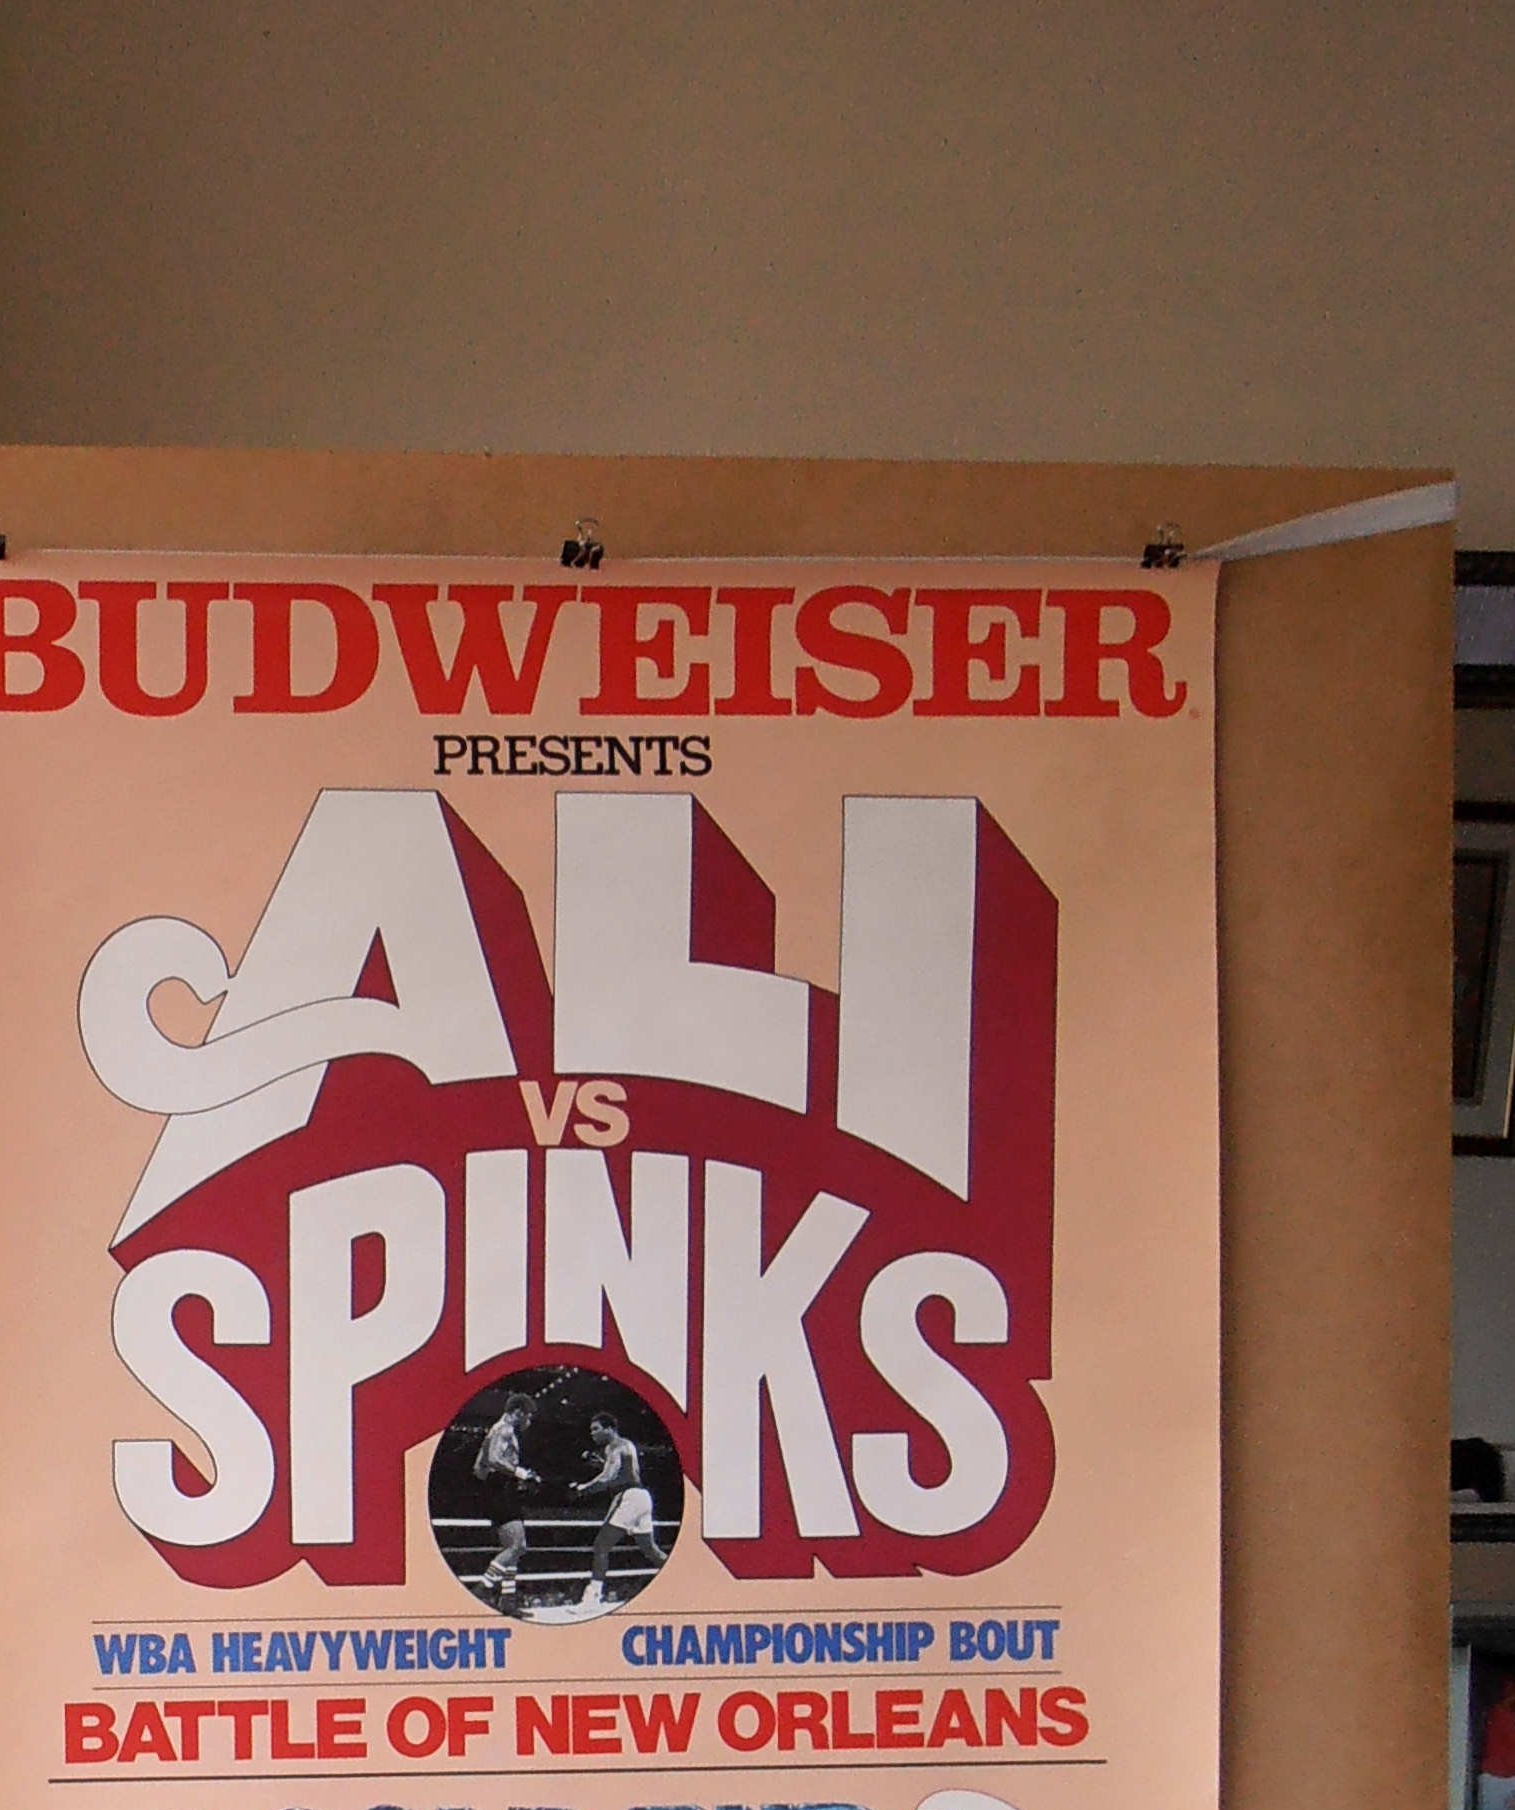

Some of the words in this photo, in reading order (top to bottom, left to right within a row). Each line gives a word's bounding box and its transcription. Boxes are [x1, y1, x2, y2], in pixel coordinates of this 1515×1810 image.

[433, 734, 713, 777] PRESENTS
[78, 788, 978, 1252] ALI
[518, 1080, 631, 1148] VS
[110, 1147, 1009, 1547] SPINKS
[93, 1632, 197, 1675] WBA
[212, 1627, 512, 1673] HEAVYWEIGHT
[622, 1622, 934, 1667] CHAMPIONSHIP
[949, 1618, 1061, 1662] BOUT
[64, 1697, 368, 1764] BATTLE
[386, 1695, 494, 1759] OF
[515, 1692, 701, 1757] NEW
[717, 1685, 1090, 1753] ORLEANS
